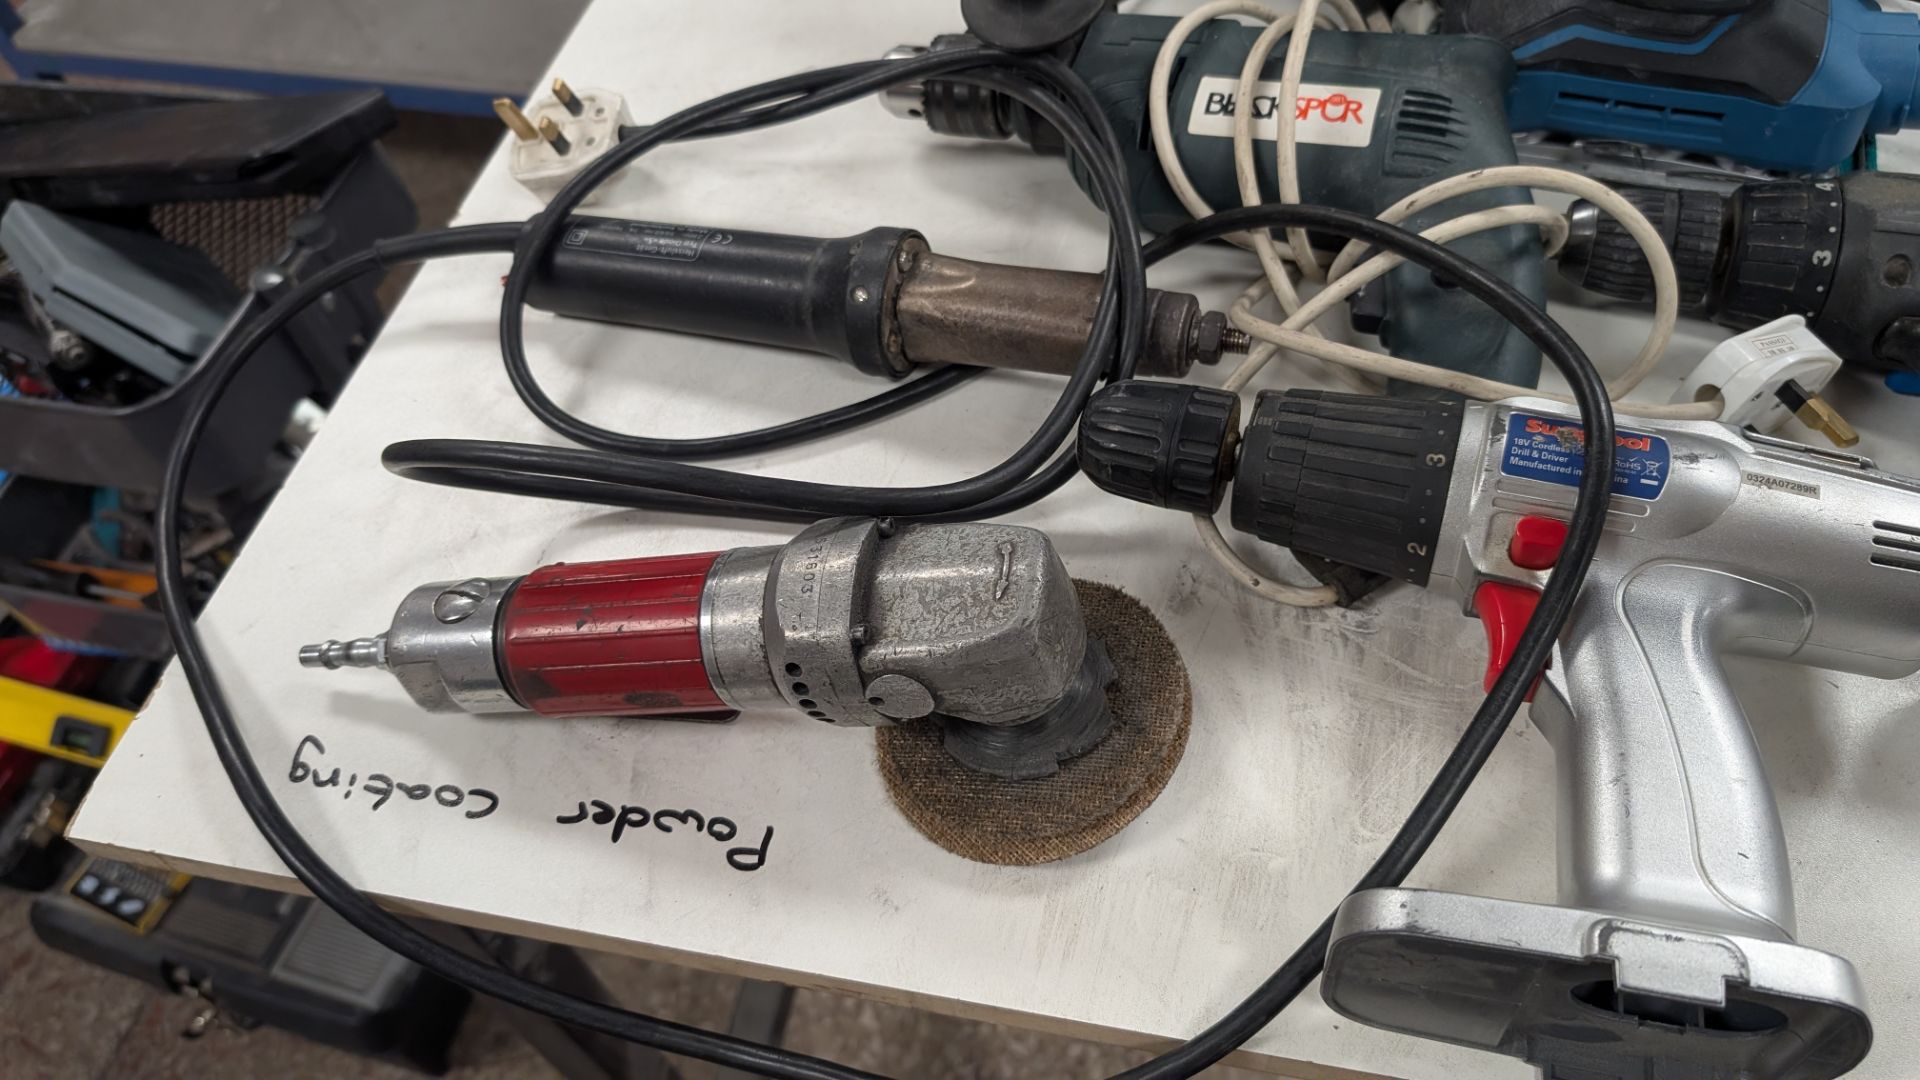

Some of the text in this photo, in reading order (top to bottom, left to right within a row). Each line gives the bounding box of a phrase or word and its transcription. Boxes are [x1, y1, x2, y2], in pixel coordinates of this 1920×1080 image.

[1814, 182, 1835, 192] 4
[1812, 249, 1832, 267] 3
[1513, 437, 1531, 447] 18V
[1425, 453, 1446, 468] 3
[1511, 446, 1569, 463] Drill & Driver
[1509, 456, 1572, 474] Manufactured
[1573, 467, 1582, 476] in
[1406, 542, 1428, 557] 2
[557, 799, 773, 872] Powder
